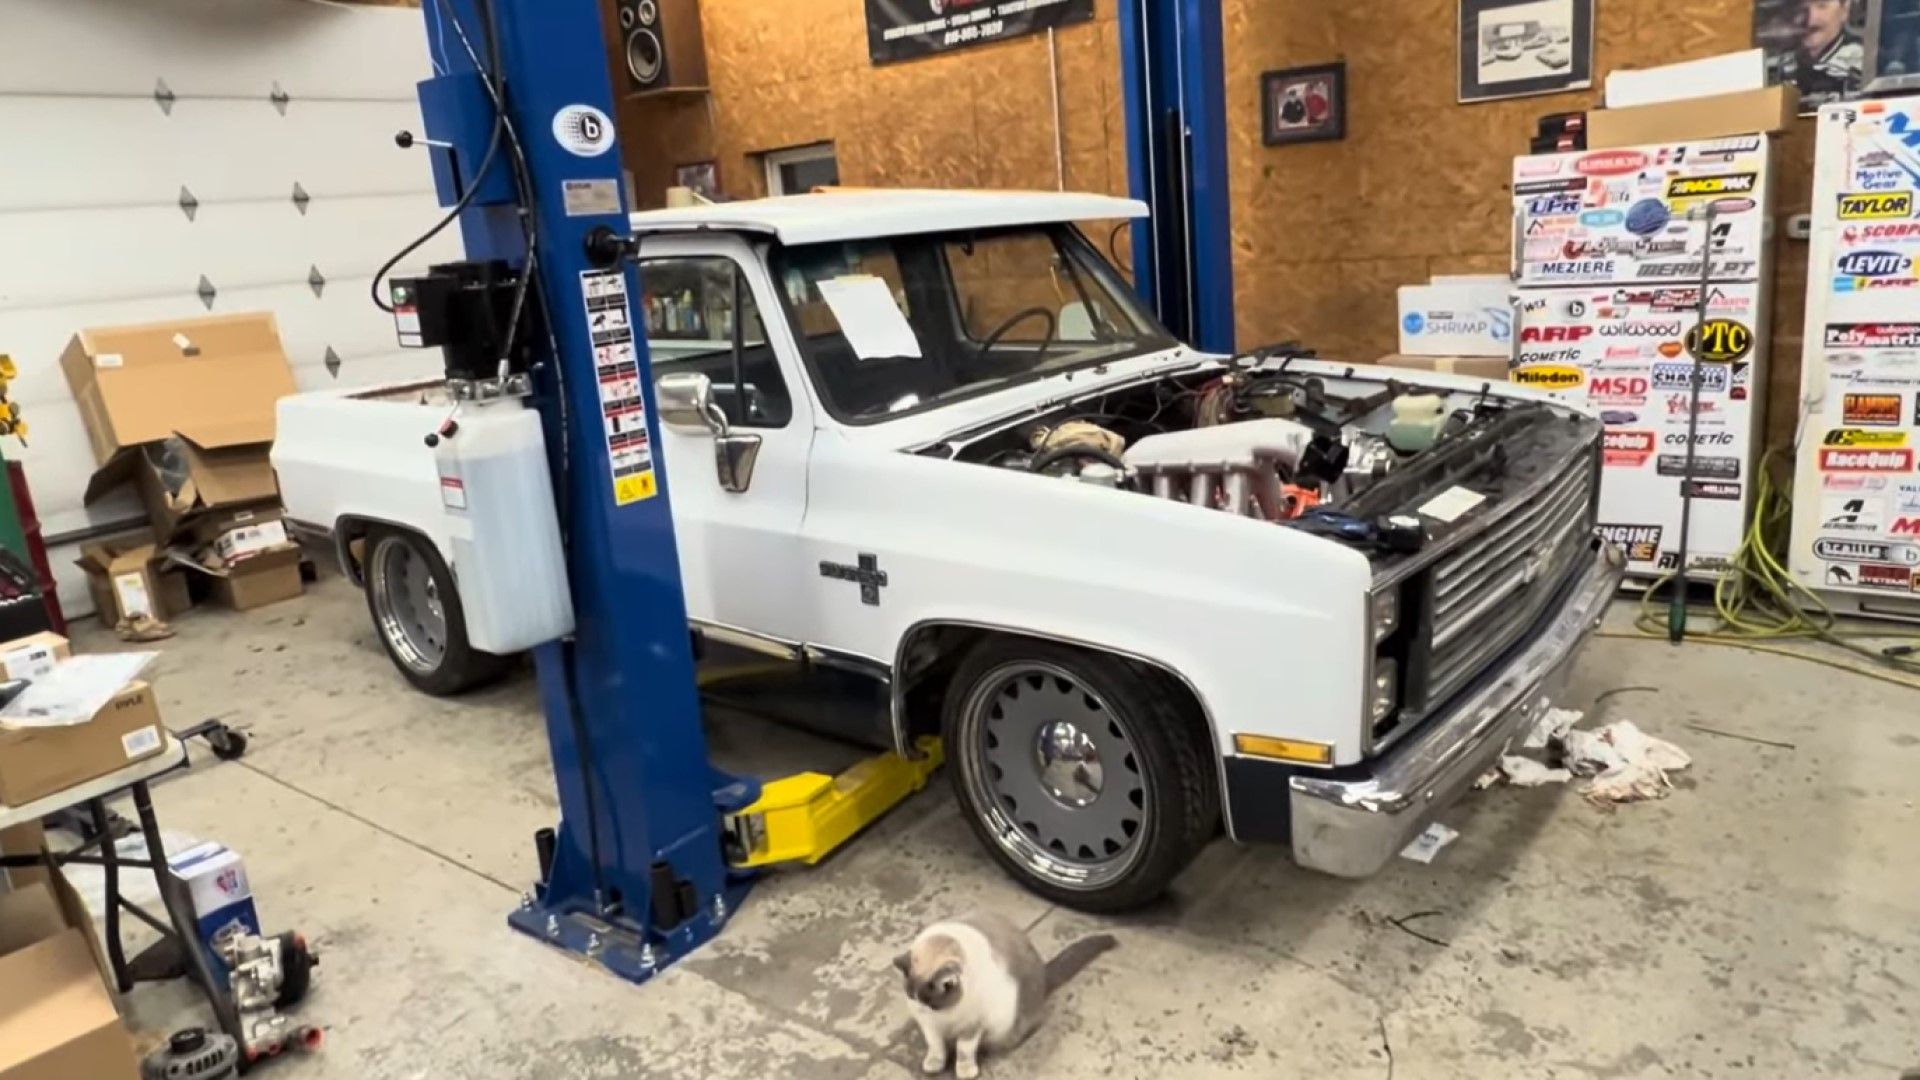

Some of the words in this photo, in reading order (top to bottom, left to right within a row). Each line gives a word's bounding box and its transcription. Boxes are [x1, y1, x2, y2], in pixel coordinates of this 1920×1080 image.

[1842, 197, 1908, 214] TAYLOR
[1861, 223, 1920, 238] SCORP
[1541, 260, 1615, 274] MEZIERE
[1427, 321, 1487, 334] SHRIMP
[1520, 326, 1593, 343] ARP
[1599, 320, 1681, 336] wilwood
[1692, 321, 1747, 352] PTC
[1516, 371, 1579, 383] Milodon
[1589, 377, 1648, 395] MSD
[1592, 526, 1661, 543] ENGINE
